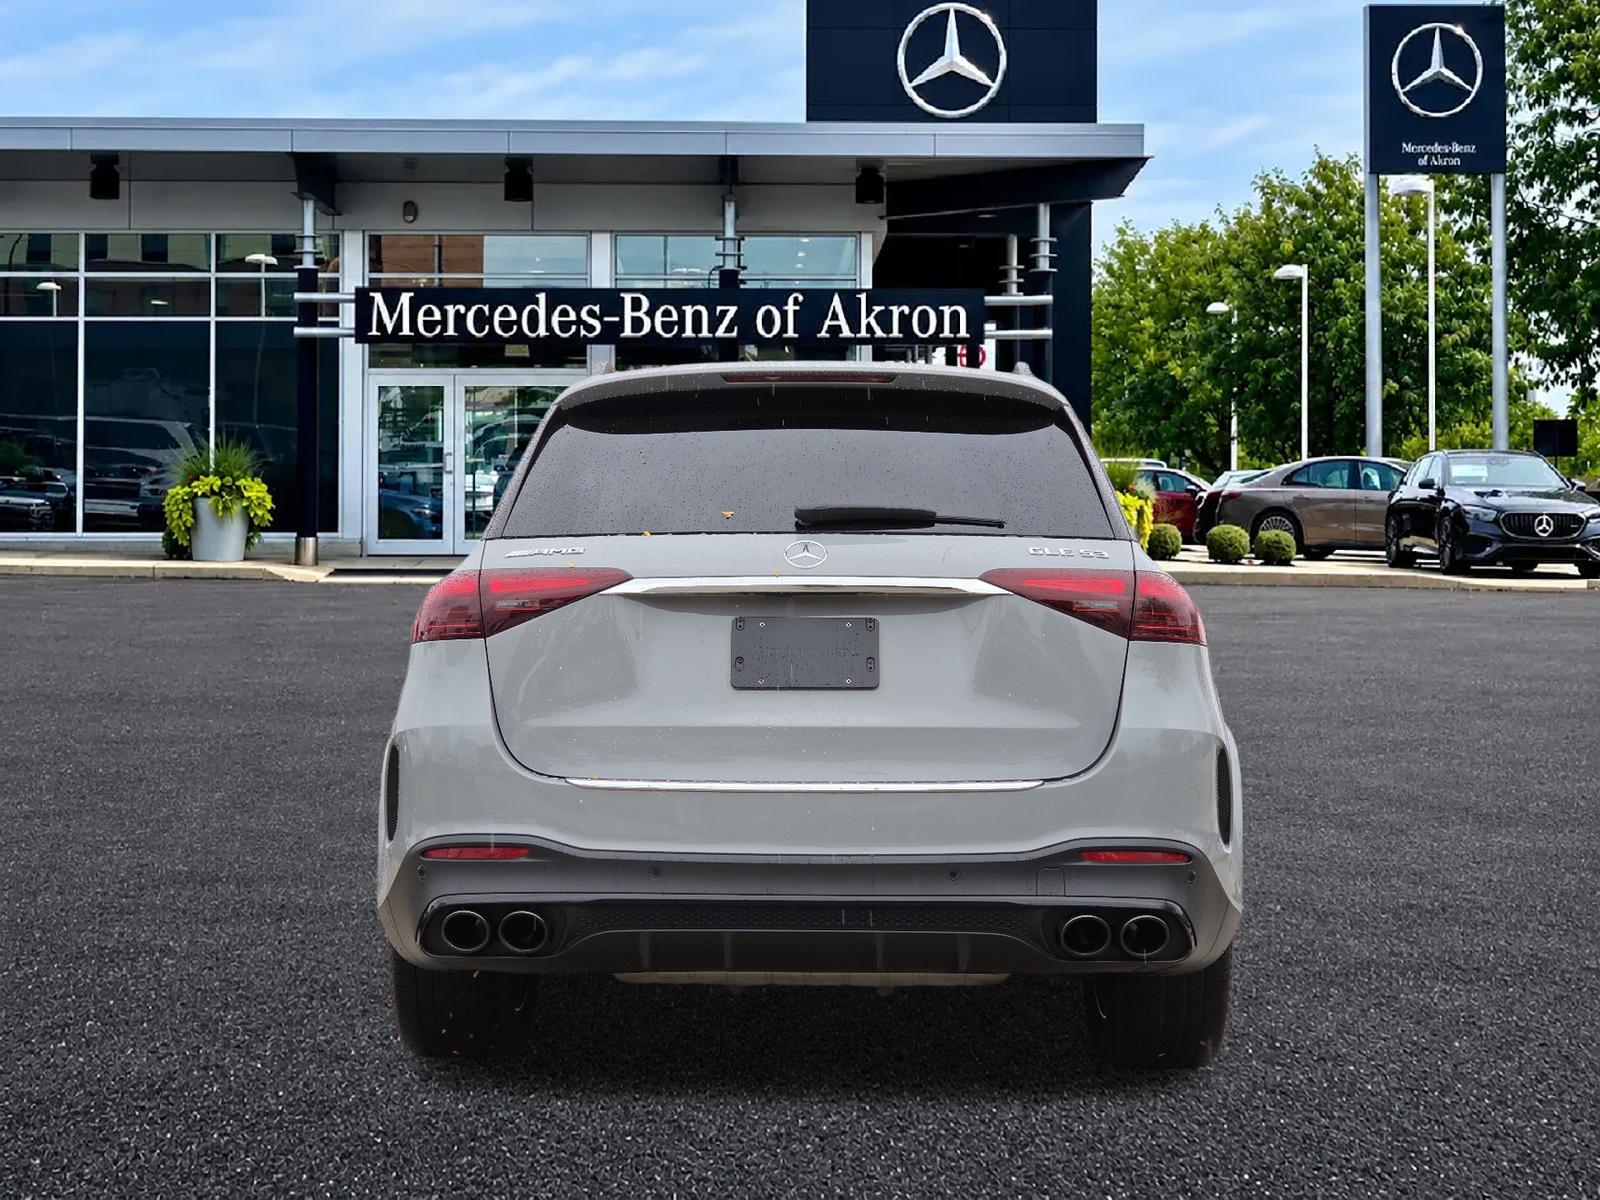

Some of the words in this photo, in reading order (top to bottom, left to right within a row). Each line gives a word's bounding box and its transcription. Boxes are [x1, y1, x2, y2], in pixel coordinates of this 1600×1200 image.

[1401, 142, 1477, 153] Mercedes-Benz
[1418, 155, 1428, 166] of
[1430, 155, 1461, 166] Akron
[367, 291, 738, 339] Mercedes-Benz
[756, 291, 803, 338] of
[816, 291, 970, 338] Akron
[527, 547, 585, 556] AMG
[1028, 547, 1075, 557] GLE
